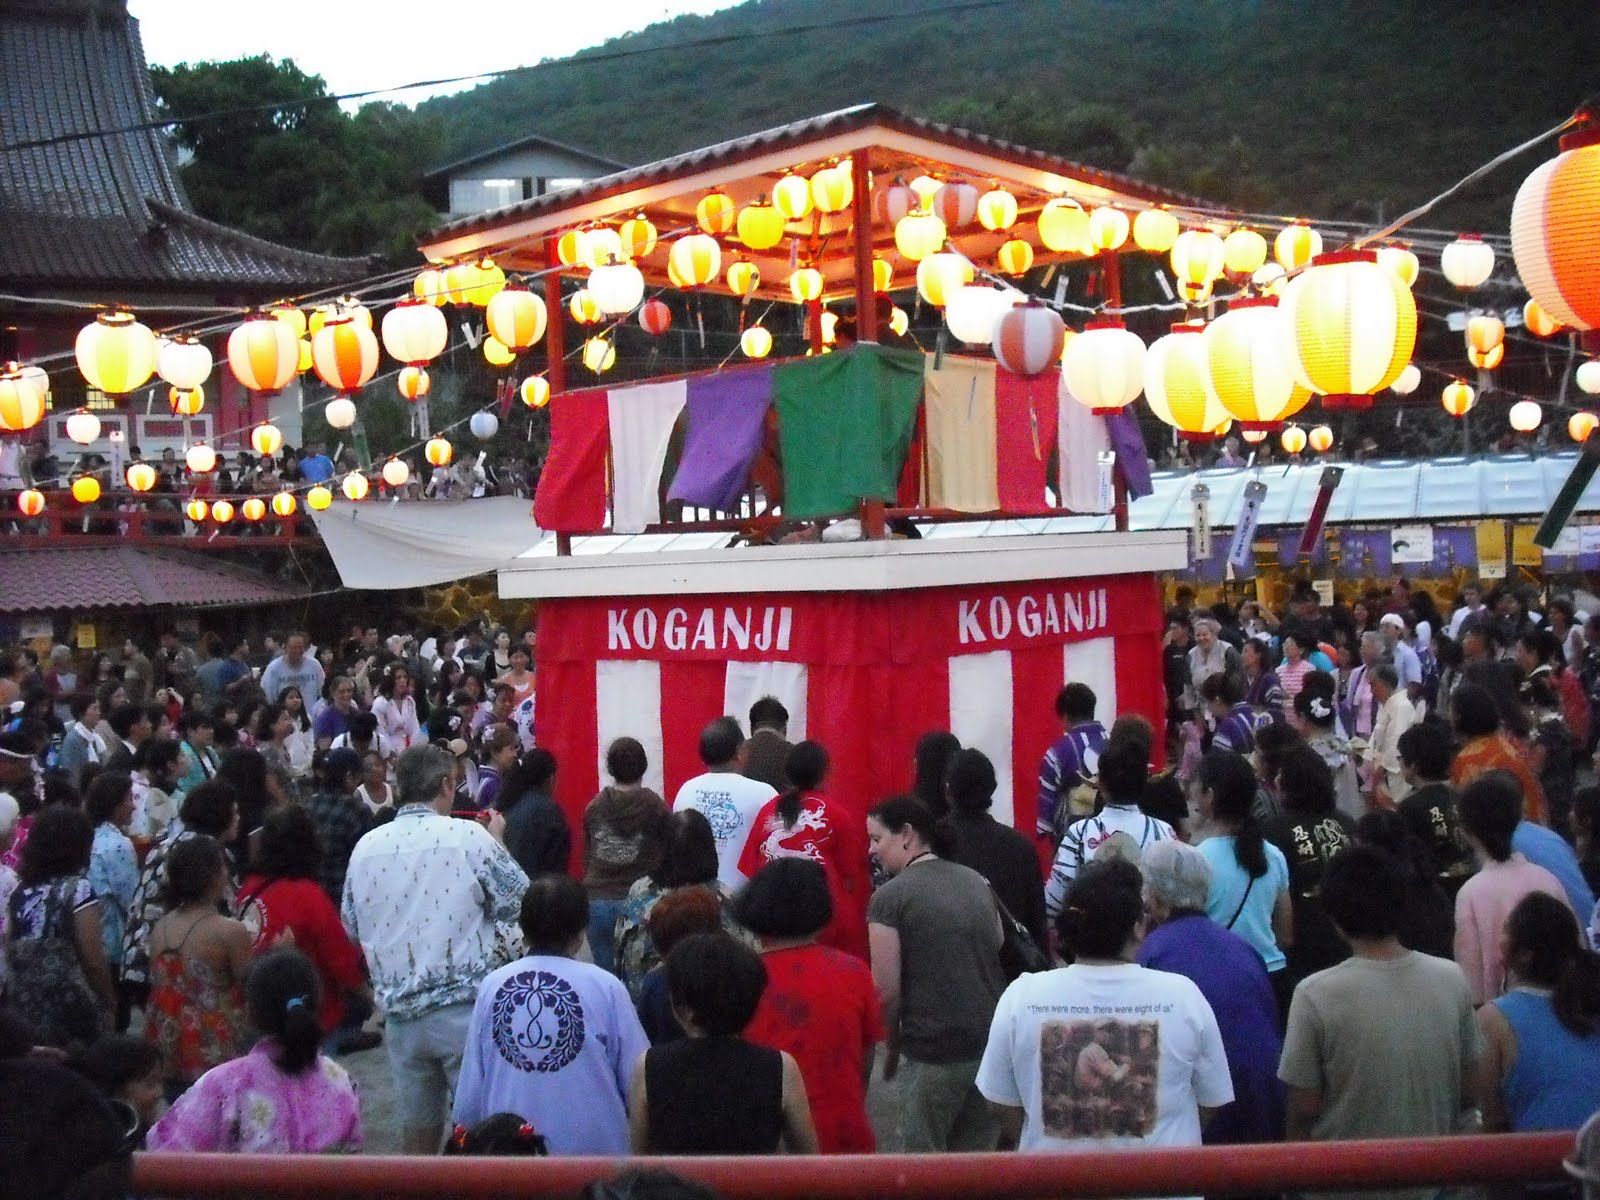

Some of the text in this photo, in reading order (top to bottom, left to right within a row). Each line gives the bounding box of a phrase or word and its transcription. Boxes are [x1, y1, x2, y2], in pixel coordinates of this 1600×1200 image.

[607, 606, 793, 652] KOGANJI
[958, 588, 1107, 644] KOGANJI
[1051, 1005, 1069, 1014] were
[1093, 1004, 1113, 1015] there
[1114, 1004, 1133, 1014] were
[1134, 1003, 1153, 1016] eight
[1153, 1003, 1161, 1013] of
